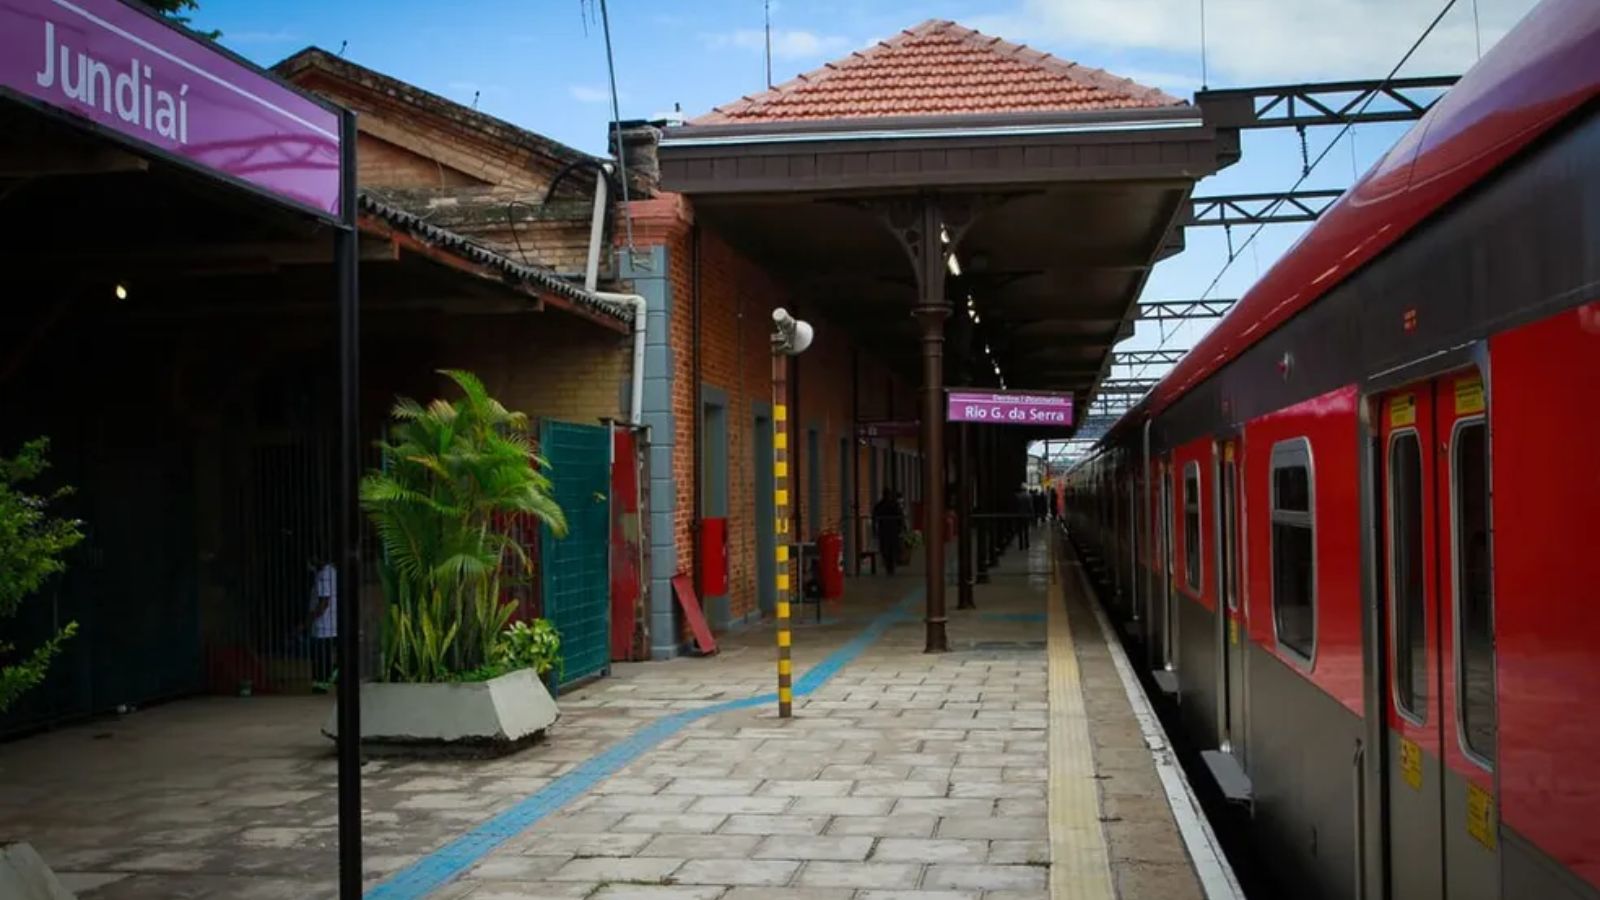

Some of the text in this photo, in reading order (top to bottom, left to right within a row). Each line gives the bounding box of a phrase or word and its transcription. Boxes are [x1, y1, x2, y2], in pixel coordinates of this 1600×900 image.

[37, 21, 189, 144] Jundiaí
[965, 405, 1065, 422] Rio G. da Serra
